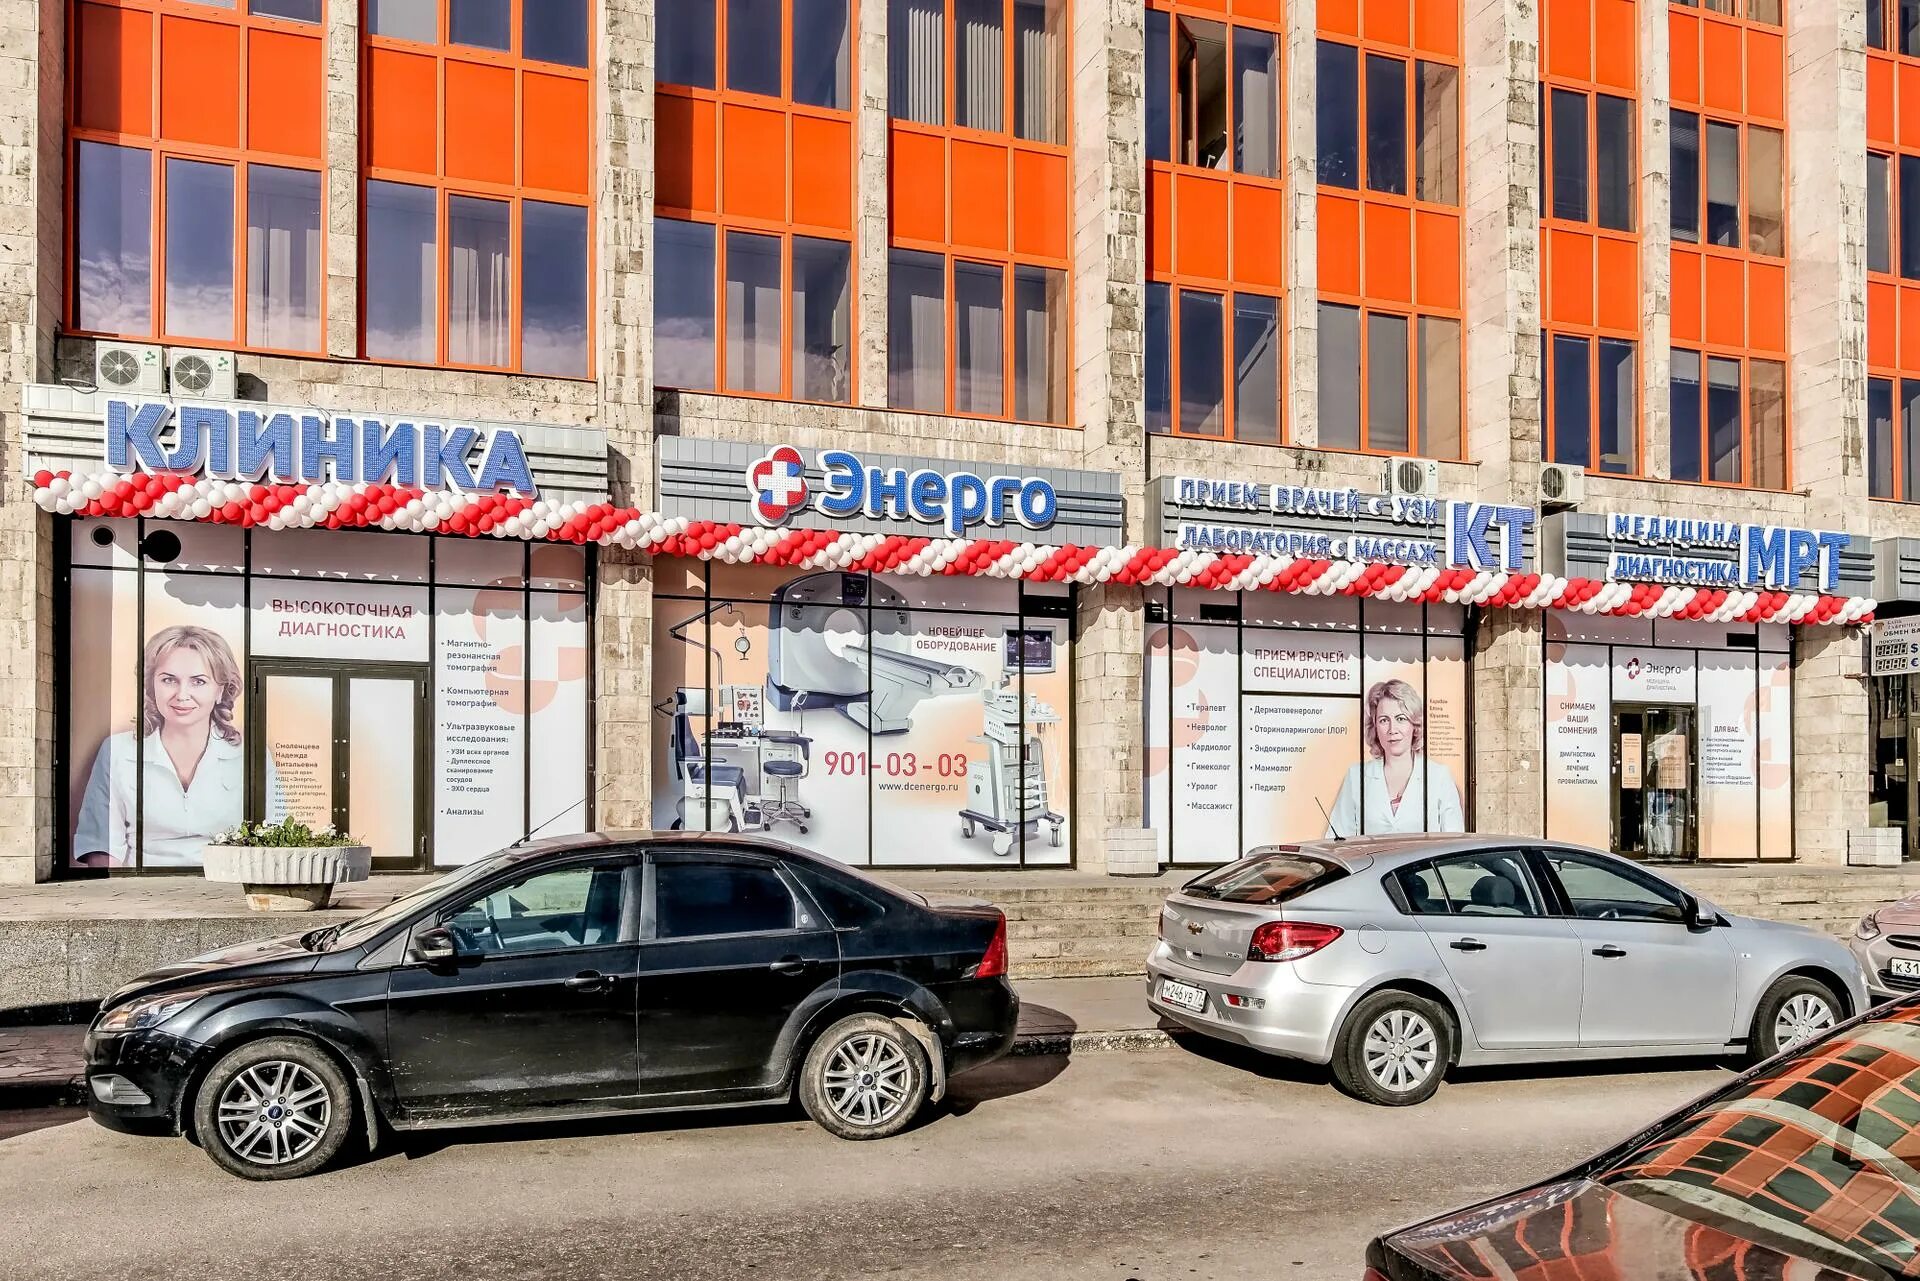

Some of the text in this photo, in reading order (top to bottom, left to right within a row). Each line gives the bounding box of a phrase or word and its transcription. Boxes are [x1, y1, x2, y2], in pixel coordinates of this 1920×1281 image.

[106, 399, 535, 494] КЛИНИКА
[821, 451, 1057, 534] Энерго
[1179, 478, 1438, 524] ПРИЕМ ВРАЧЕЙ УЗИ
[1614, 514, 1741, 543] МЕДИЦИНА
[1451, 502, 1535, 570] КТ
[1183, 525, 1438, 563] ЛАБОРАТОРИЯ МАССАЖ
[1747, 525, 1850, 590] МРТ
[1614, 556, 1740, 583] ДИАГНОСТИКА
[272, 599, 412, 618] ВЫСОКОТОЧНАЯ
[278, 621, 406, 640] ДИАГНОСТИКА
[928, 626, 985, 637] НОВЕЙШЕЕ
[1883, 629, 1909, 637] ОБМЕН
[447, 640, 492, 648] Магнитно-
[916, 640, 997, 652] ОБОРУДОВАНИЕ
[447, 652, 501, 660] резонансная
[1254, 648, 1345, 663] ПРИЕМ ВРАЧЕЙ
[446, 664, 497, 672] томография
[1646, 662, 1682, 676] Энерго
[1253, 667, 1351, 681] СПЕЦИАЛИСТОВ:
[447, 686, 509, 697] Компьютерная
[446, 699, 497, 708] томография
[1191, 703, 1227, 713] Терапевт
[1560, 702, 1596, 711] СНИМАЕМ
[1253, 705, 1324, 717] Дерматовенеролог
[1566, 715, 1589, 723] ВАШИ
[446, 721, 516, 732] Ультразвуковые
[1191, 723, 1228, 734] Невролог
[1254, 724, 1326, 736] Оториноларинголог
[1558, 726, 1598, 735] СОМНЕНИЯ
[446, 735, 509, 743] исследования:
[1191, 743, 1232, 754] Кардиолог
[1254, 744, 1307, 755] Эндокринолог
[275, 751, 308, 759] Надежда
[275, 760, 318, 768] Витальевна
[450, 757, 491, 765] Дуплексное
[1191, 763, 1231, 773] Гинеколог
[1254, 764, 1293, 774] Маммолог
[878, 781, 959, 794] www.dcenergo.ru
[1191, 782, 1218, 792] Уролог
[1557, 778, 1598, 786] ПРОФИЛАКТИКА
[1254, 783, 1286, 794] Педиатр
[446, 807, 485, 816] Анализы
[1191, 802, 1233, 811] Массажист
